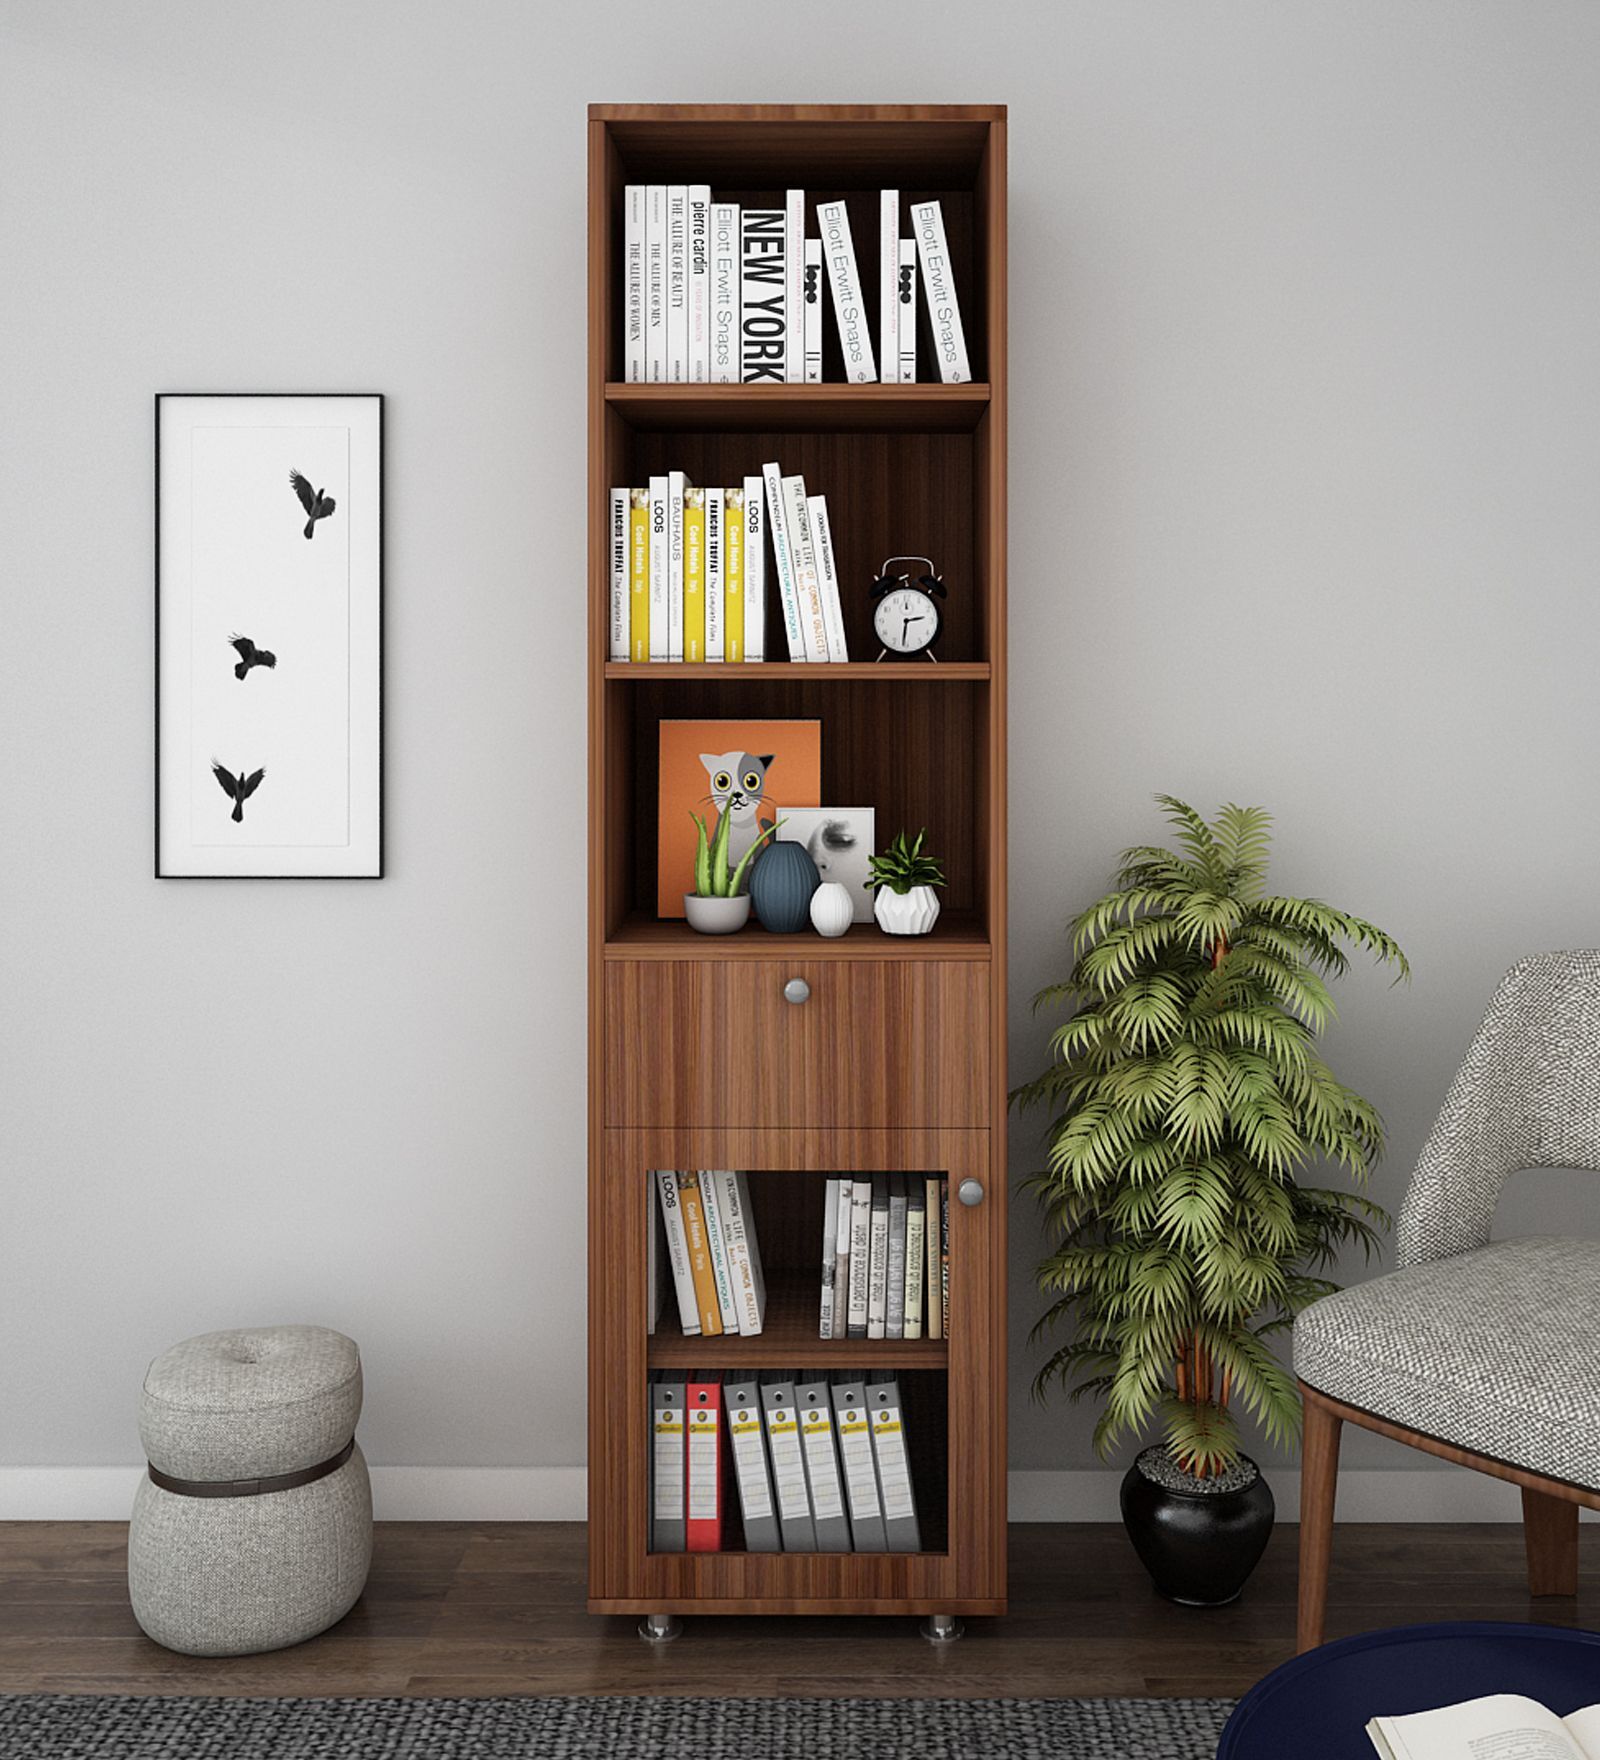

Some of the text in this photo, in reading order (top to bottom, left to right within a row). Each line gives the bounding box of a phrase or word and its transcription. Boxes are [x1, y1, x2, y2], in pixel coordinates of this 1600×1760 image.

[672, 197, 682, 309] THE ALLURE OF BEAUTY
[691, 202, 707, 275] pierre cardin
[630, 243, 640, 342] THE ALLURE OF WOMEN
[651, 243, 660, 327] THE ALLURE OF MEN
[715, 208, 732, 365] Elliott Erwitt Snaps
[743, 212, 786, 384] NEW YORK
[824, 206, 863, 363] Elliott Erwitt Snaps
[918, 206, 958, 363] Elliott Erwitt Snaps
[636, 525, 644, 544] Cool
[654, 500, 664, 533] LOOS
[672, 497, 681, 561] BAUHAUS
[690, 525, 699, 544] Cool
[730, 525, 739, 544] Cool
[749, 500, 758, 533] LOOS
[636, 547, 644, 574] Hotels
[690, 547, 699, 574] Hotels
[730, 547, 739, 574] Hotels
[776, 533, 791, 598] ARCHITECTURAL
[786, 599, 798, 640] ANTIQUES
[803, 547, 812, 565] LIFE
[813, 619, 825, 655] OBJECTS
[662, 1175, 676, 1208] LOOS
[687, 1201, 698, 1220] Cool
[690, 1223, 702, 1249] Hotels
[708, 1205, 724, 1268] ARCHITECTURAL
[718, 1270, 730, 1311] ANTIQUES
[734, 1221, 744, 1240] LIFE
[745, 1292, 758, 1328] OBJECTS
